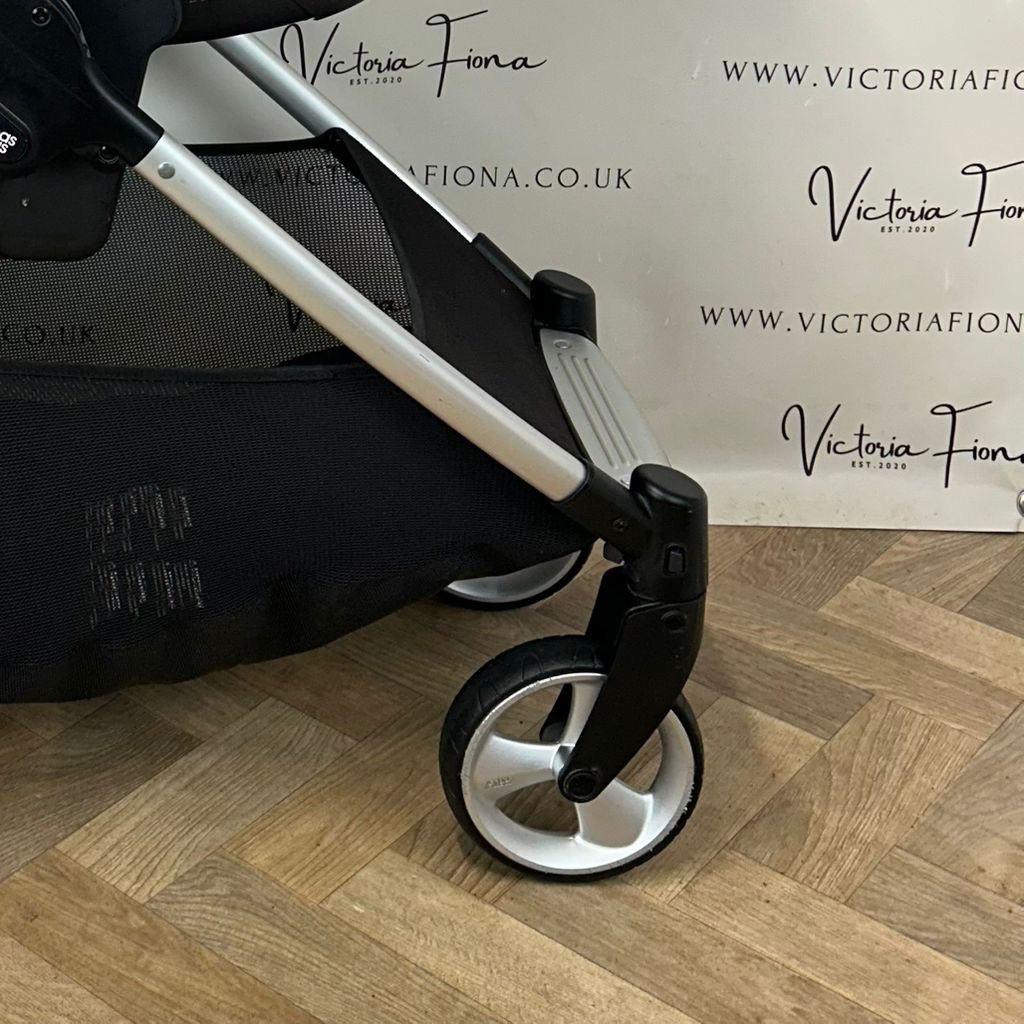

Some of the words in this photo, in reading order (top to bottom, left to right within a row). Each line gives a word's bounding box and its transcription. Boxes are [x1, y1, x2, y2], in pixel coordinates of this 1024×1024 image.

[280, 22, 424, 86] Victoria
[425, 9, 548, 98] Fiona
[350, 76, 403, 86] EST.2020
[808, 165, 959, 243] Victoria
[881, 225, 936, 234] EST.2020
[781, 404, 930, 477] Victoria
[851, 460, 907, 470] EST.2020
